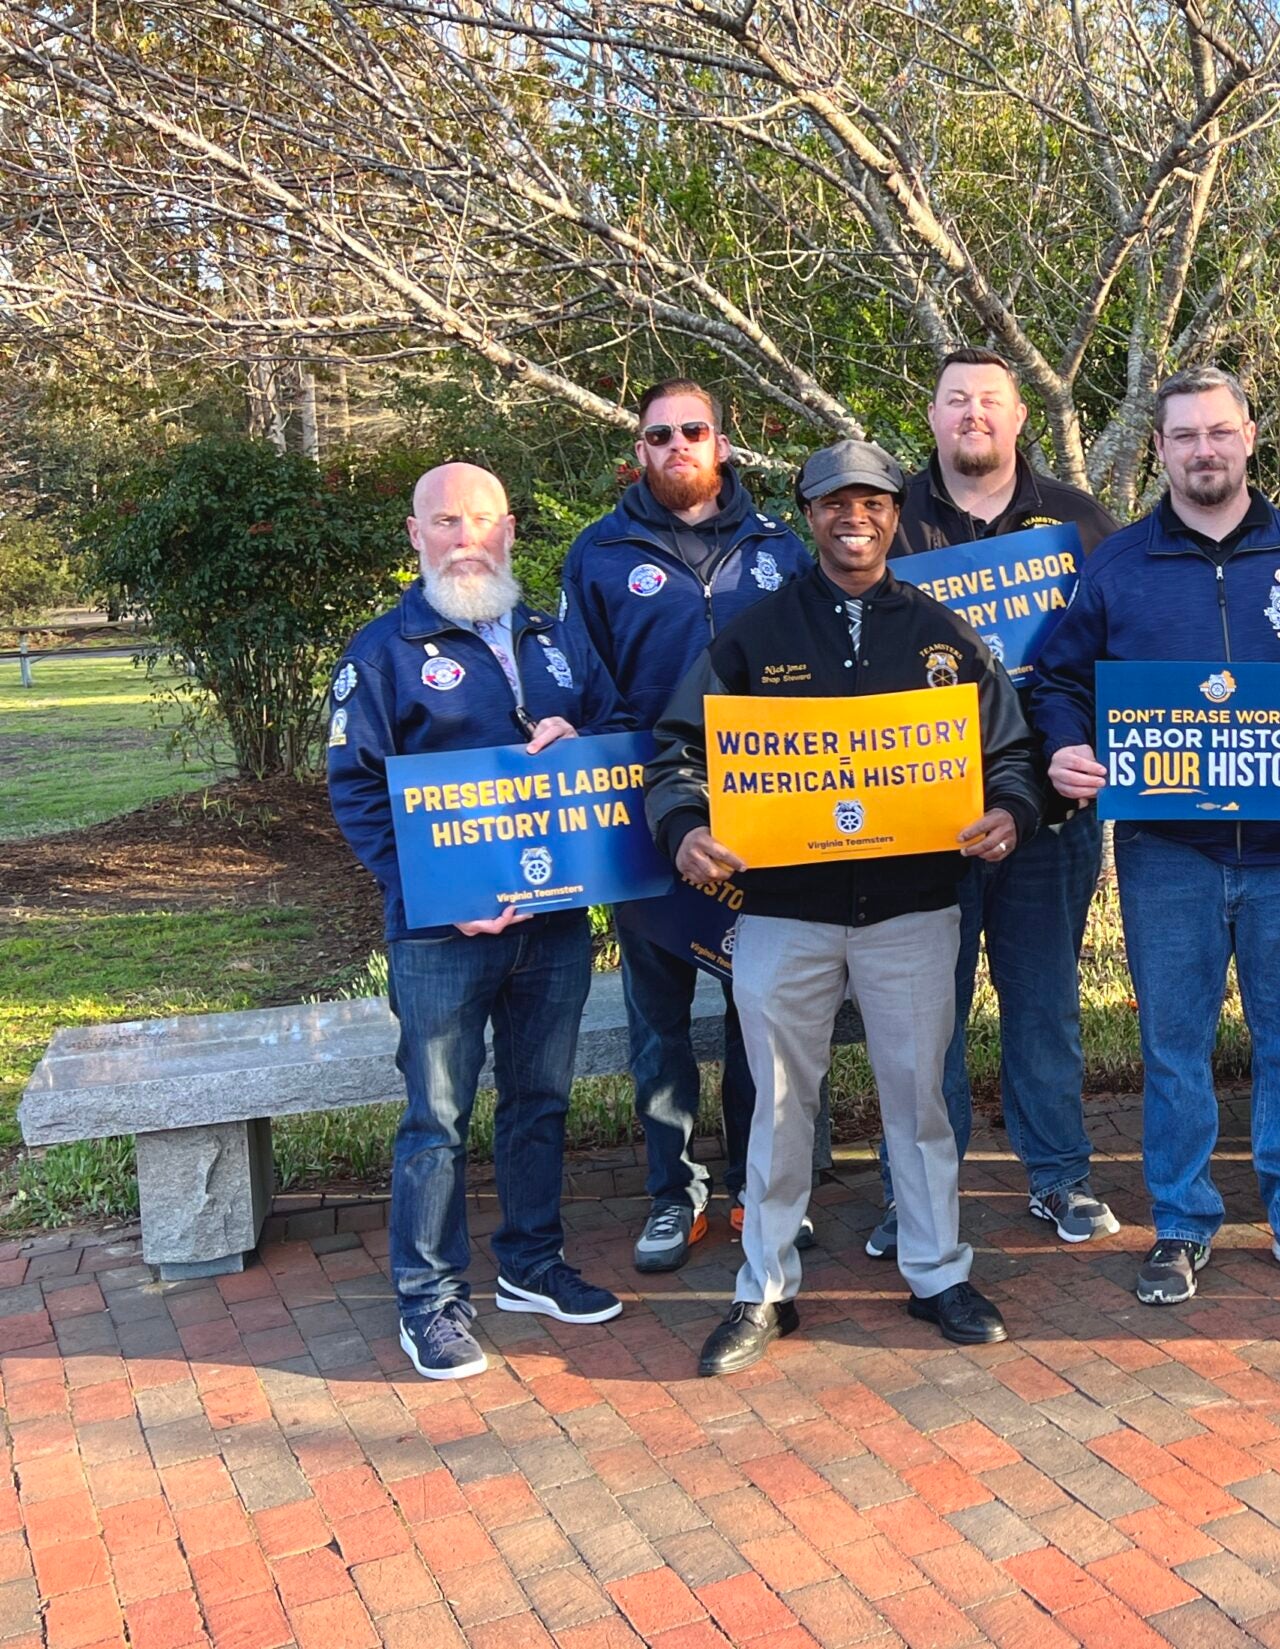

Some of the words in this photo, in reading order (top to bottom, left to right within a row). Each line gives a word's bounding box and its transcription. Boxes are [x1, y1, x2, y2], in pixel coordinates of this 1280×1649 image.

[917, 568, 996, 604] SERVE
[998, 552, 1077, 589] LABOR
[1005, 594, 1030, 620] IN
[1034, 587, 1067, 612] VA
[919, 643, 964, 660] TEAMSTERS
[1108, 709, 1166, 723] DON'T
[1171, 710, 1230, 724] ERASE
[717, 730, 838, 755] WORKER
[850, 718, 968, 752] HISTORY
[1108, 728, 1202, 748] LABOR
[722, 769, 855, 794] AMERICAN
[864, 757, 968, 788] HISTORY
[1109, 751, 1136, 786] IS
[1143, 751, 1200, 786] OUR
[404, 774, 551, 814] PRESERVE
[558, 764, 644, 797] LABOR
[432, 811, 551, 847] HISTORY
[559, 806, 587, 833] IN
[598, 801, 630, 827] VA
[808, 839, 843, 849] Virginia
[846, 836, 894, 846] Teamsters
[496, 891, 533, 903] Virginia
[534, 885, 584, 898] Teamsters
